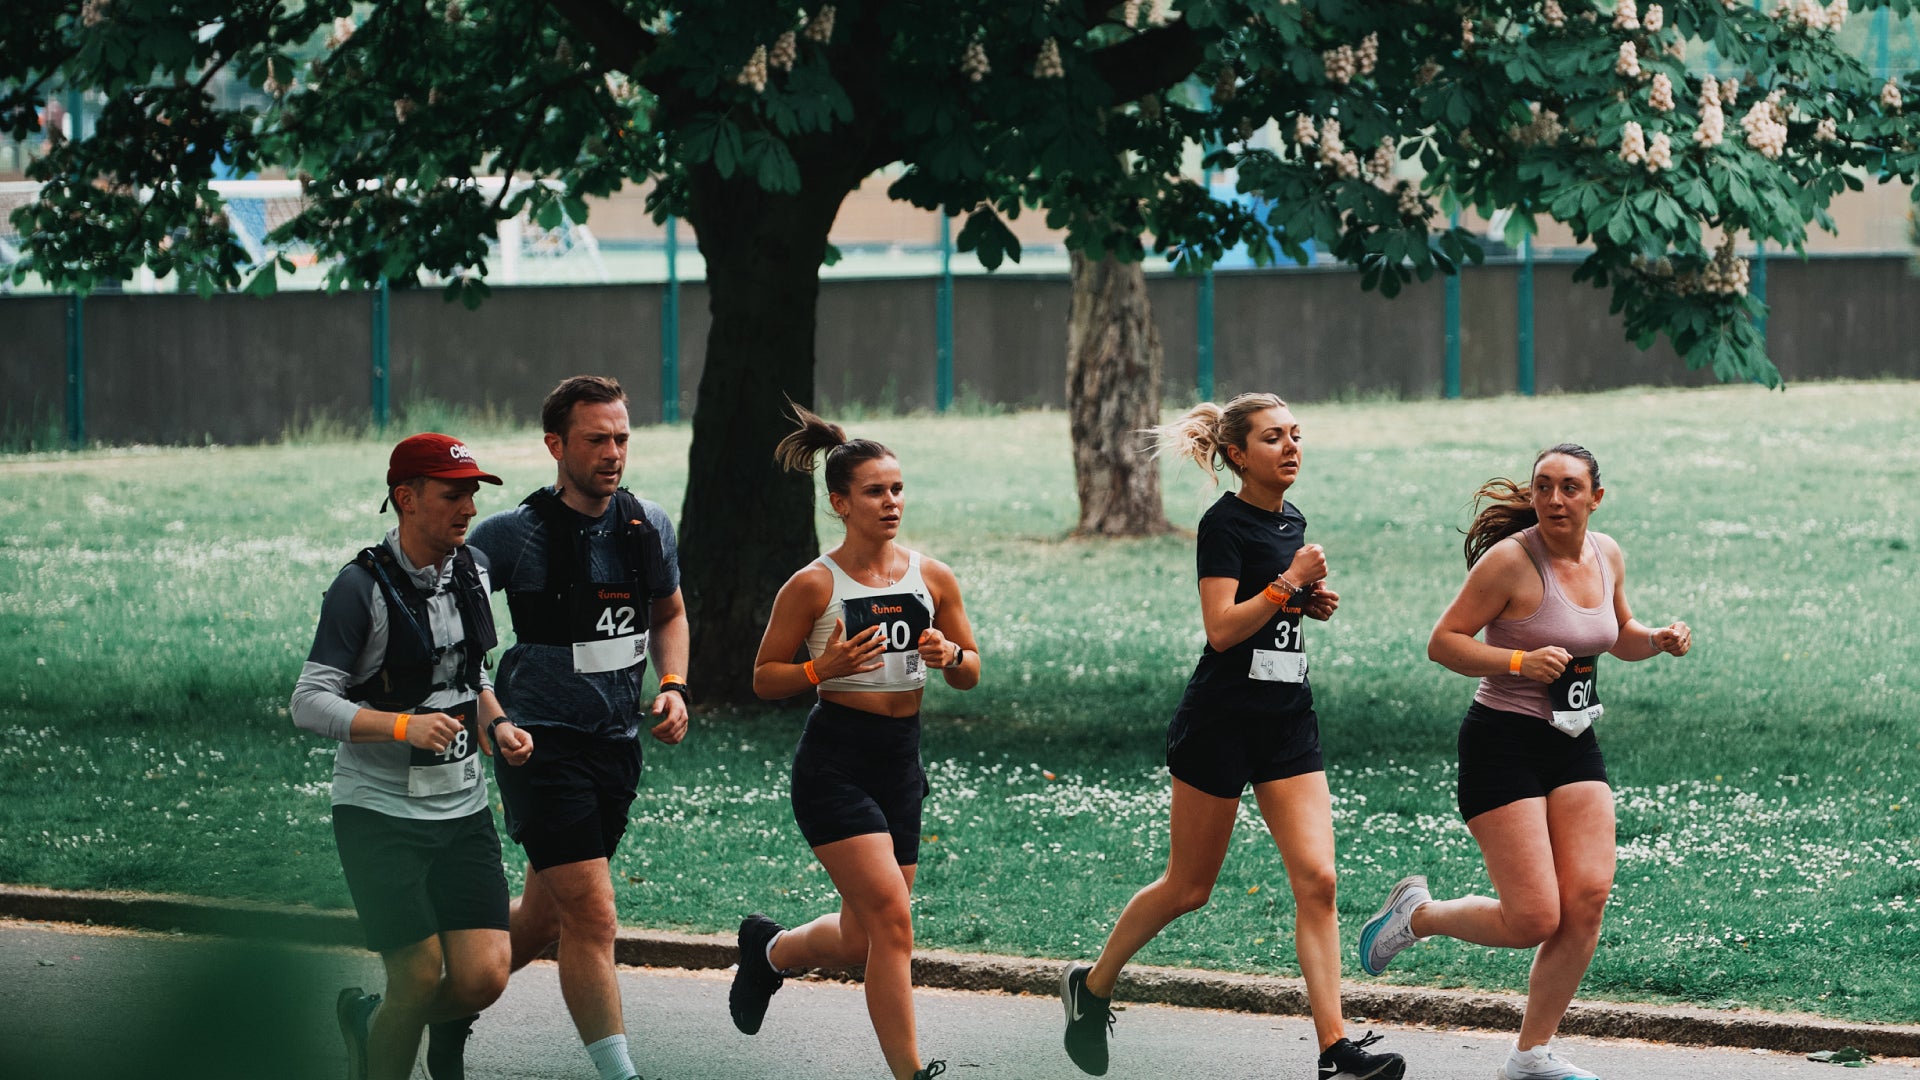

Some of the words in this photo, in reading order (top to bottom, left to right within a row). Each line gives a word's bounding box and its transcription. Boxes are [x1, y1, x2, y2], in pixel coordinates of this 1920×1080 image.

[598, 588, 631, 600] Runna
[871, 603, 903, 614] Runna
[595, 606, 636, 636] 42
[871, 620, 911, 651] 40
[1274, 620, 1301, 650] 31
[1567, 679, 1592, 709] 60
